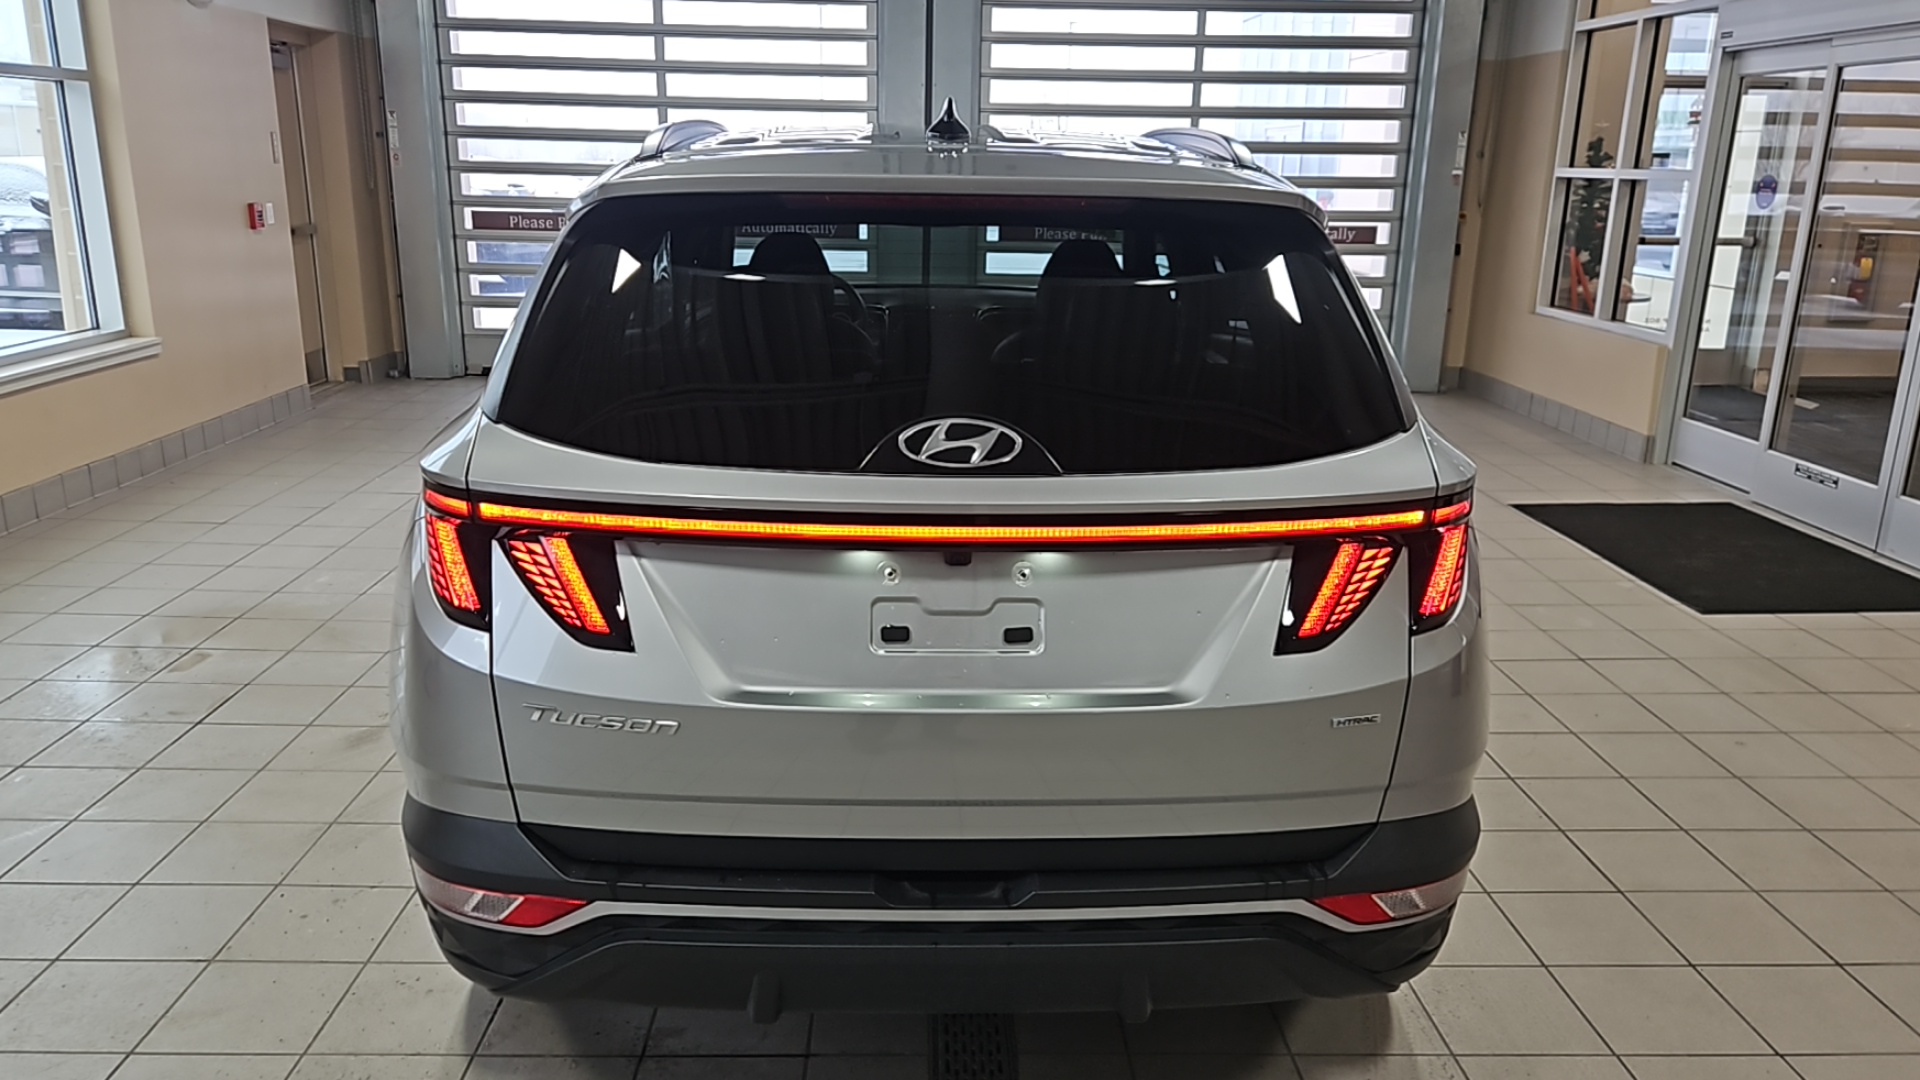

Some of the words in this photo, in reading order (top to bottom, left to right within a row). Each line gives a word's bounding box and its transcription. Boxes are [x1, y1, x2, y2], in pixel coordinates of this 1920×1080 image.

[509, 214, 553, 229] Please
[741, 224, 838, 238] Automatically
[1034, 227, 1077, 240] Please
[1335, 715, 1380, 727] HTRAC
